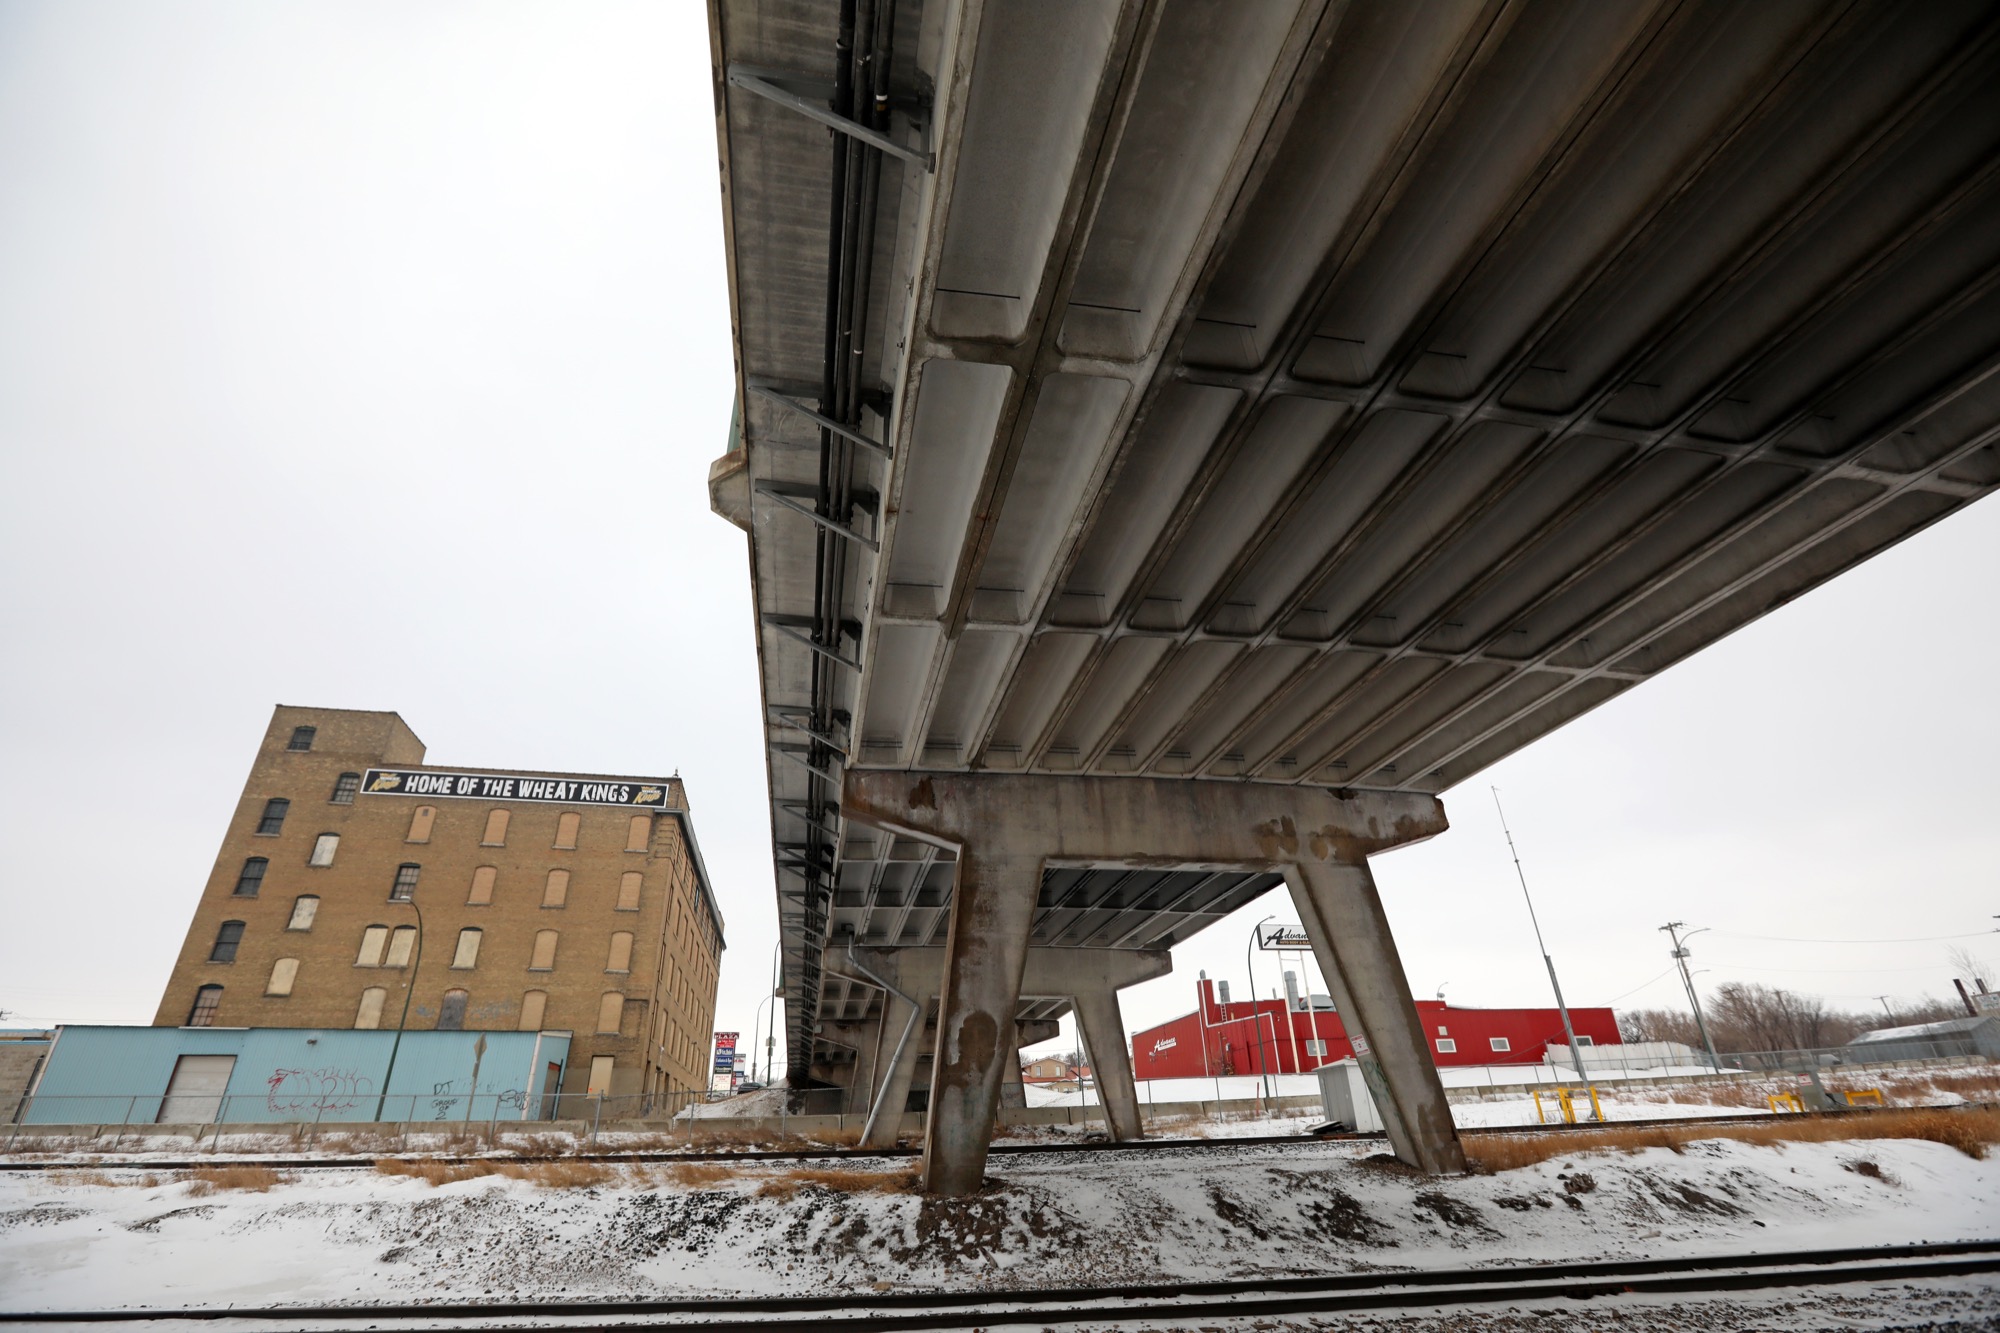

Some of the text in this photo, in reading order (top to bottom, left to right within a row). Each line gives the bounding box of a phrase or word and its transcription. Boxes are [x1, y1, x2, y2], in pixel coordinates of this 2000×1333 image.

[405, 775, 630, 803] HOME OF THE WHEAT KINGS
[1154, 1037, 1176, 1053] Advance
